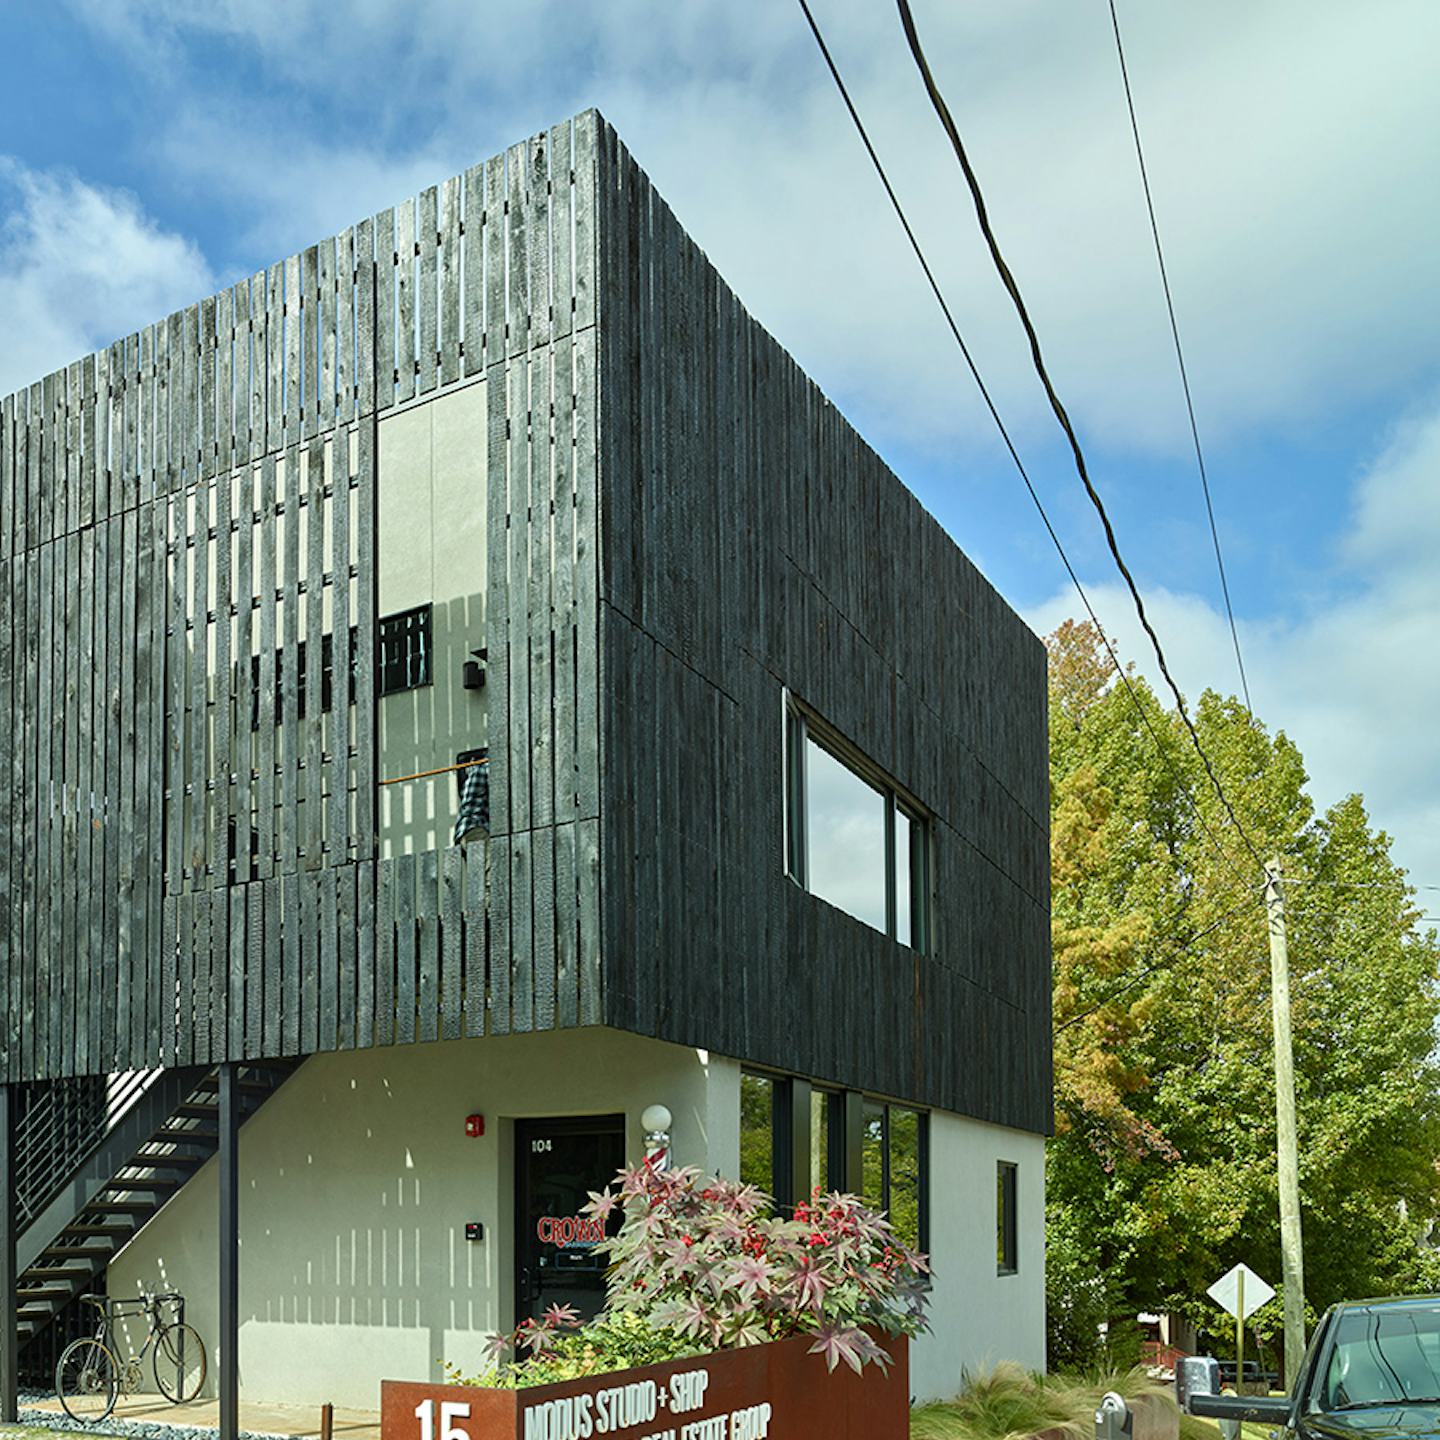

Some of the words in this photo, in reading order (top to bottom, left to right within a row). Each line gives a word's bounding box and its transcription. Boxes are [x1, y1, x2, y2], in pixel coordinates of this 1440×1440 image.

[531, 1140, 552, 1152] 104
[537, 1216, 606, 1248] CROWN
[595, 1380, 656, 1434] STUDIO
[669, 1369, 709, 1414] SHOP
